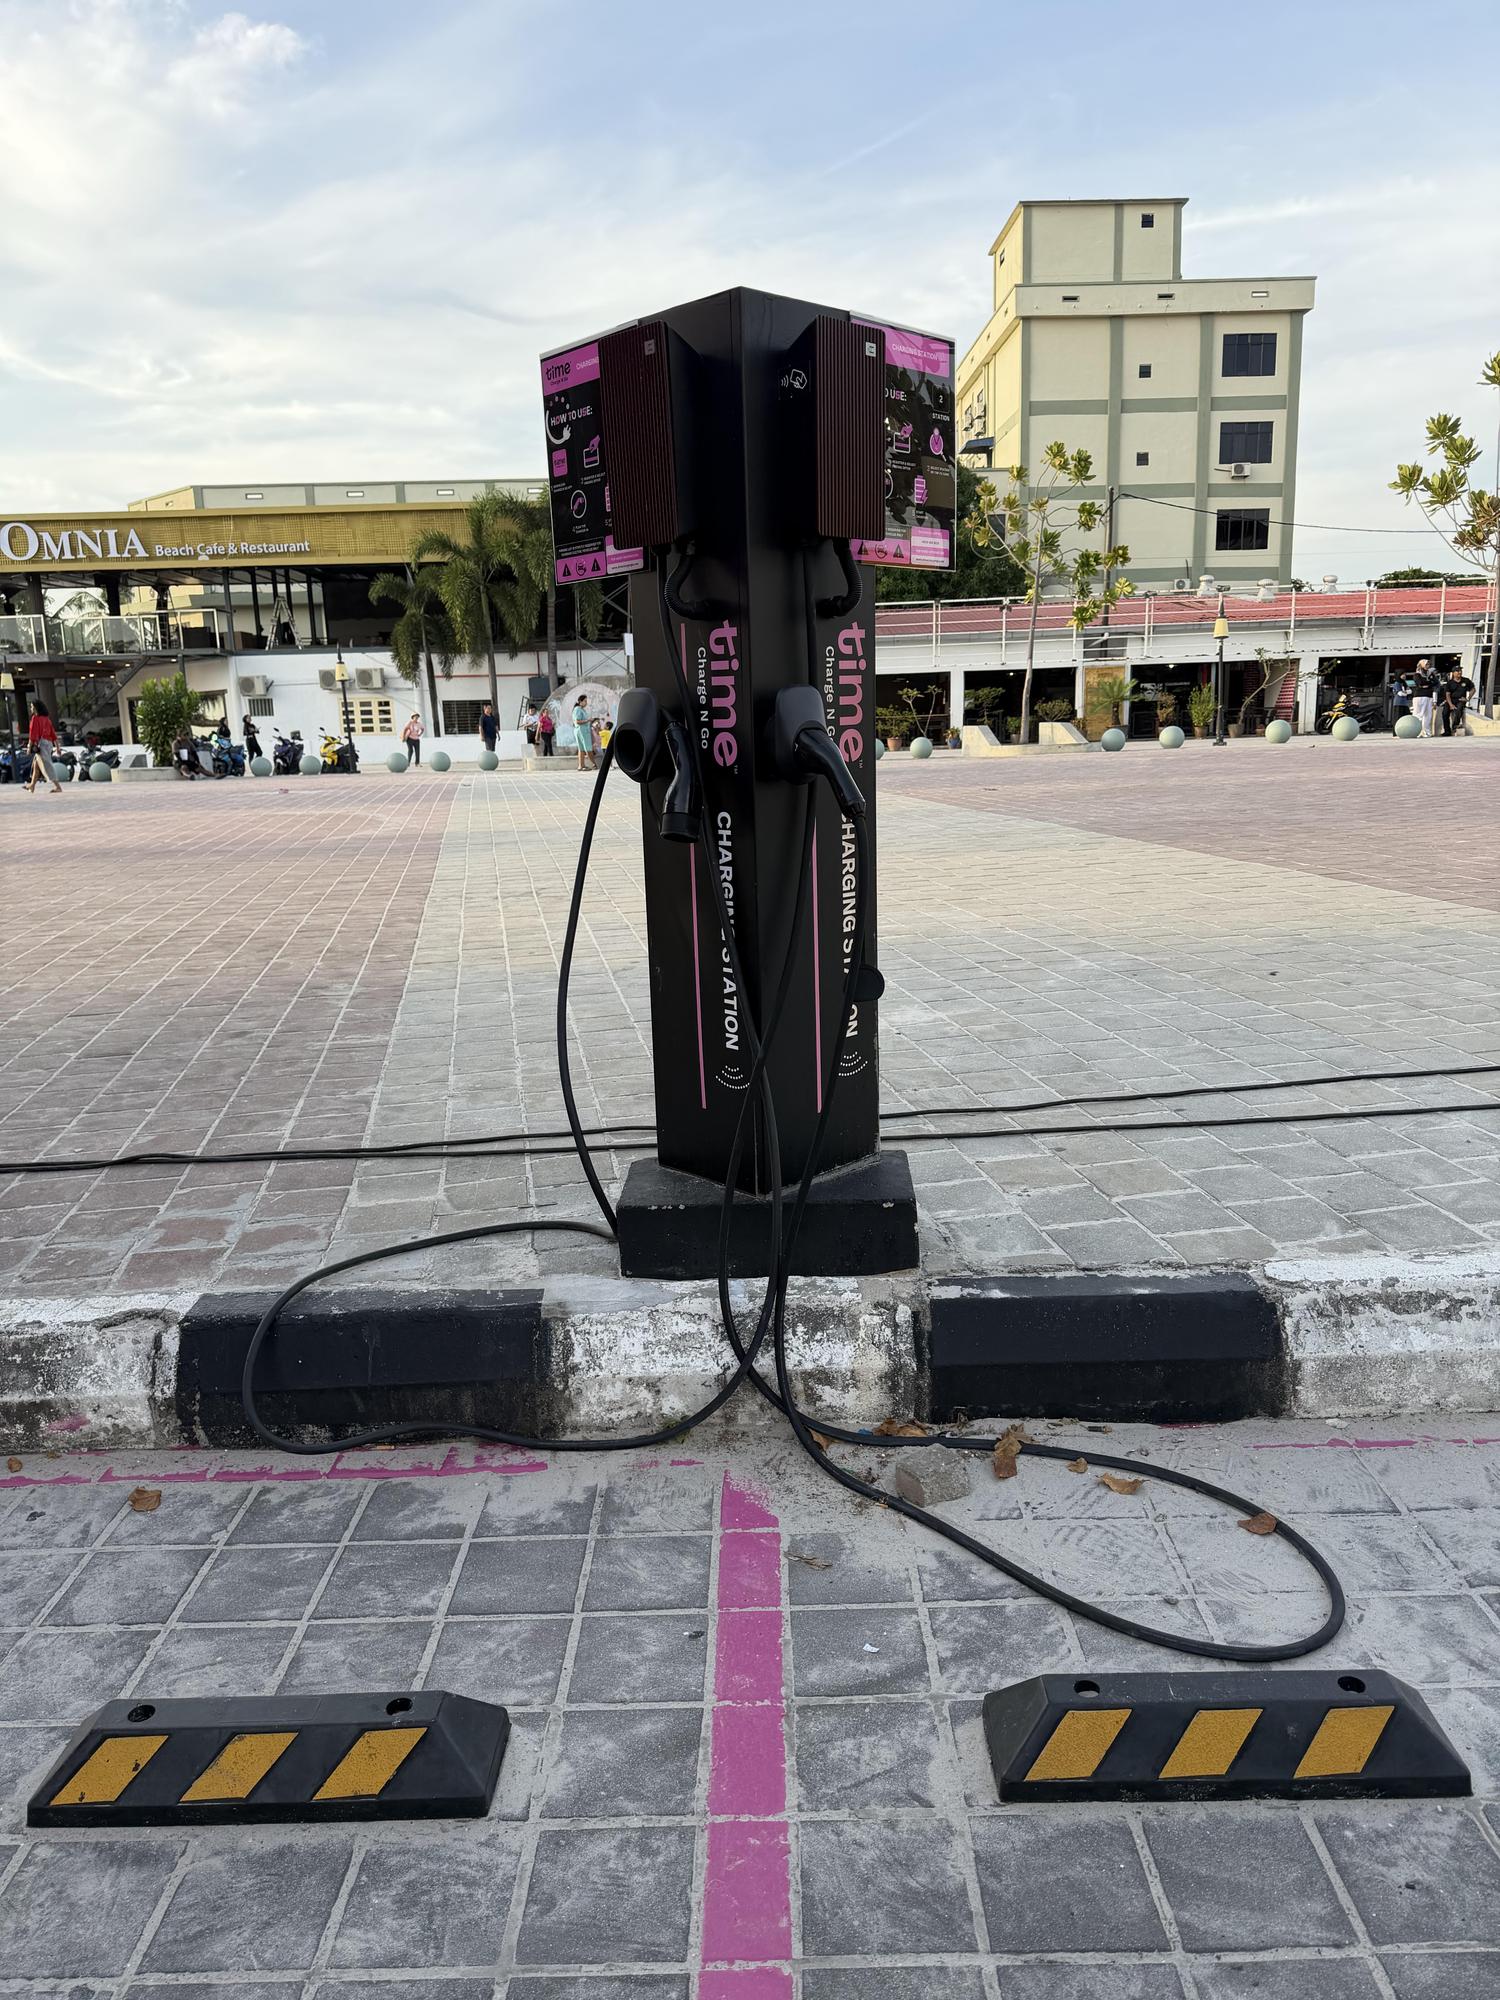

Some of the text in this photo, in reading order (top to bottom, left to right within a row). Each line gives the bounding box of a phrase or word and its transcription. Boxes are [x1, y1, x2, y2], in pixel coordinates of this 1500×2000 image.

[546, 362, 571, 381] time
[551, 405, 593, 427] HOW TO USE:
[890, 390, 907, 402] USE:
[939, 395, 944, 404] 2
[932, 412, 950, 422] STATION
[0, 521, 310, 561] OMNIA Beach Cafe & Restaurant
[697, 647, 710, 750] Charge N Go
[709, 619, 740, 768] time
[824, 645, 836, 742] Charge N G
[838, 621, 867, 764] time
[841, 812, 857, 933] HARGING
